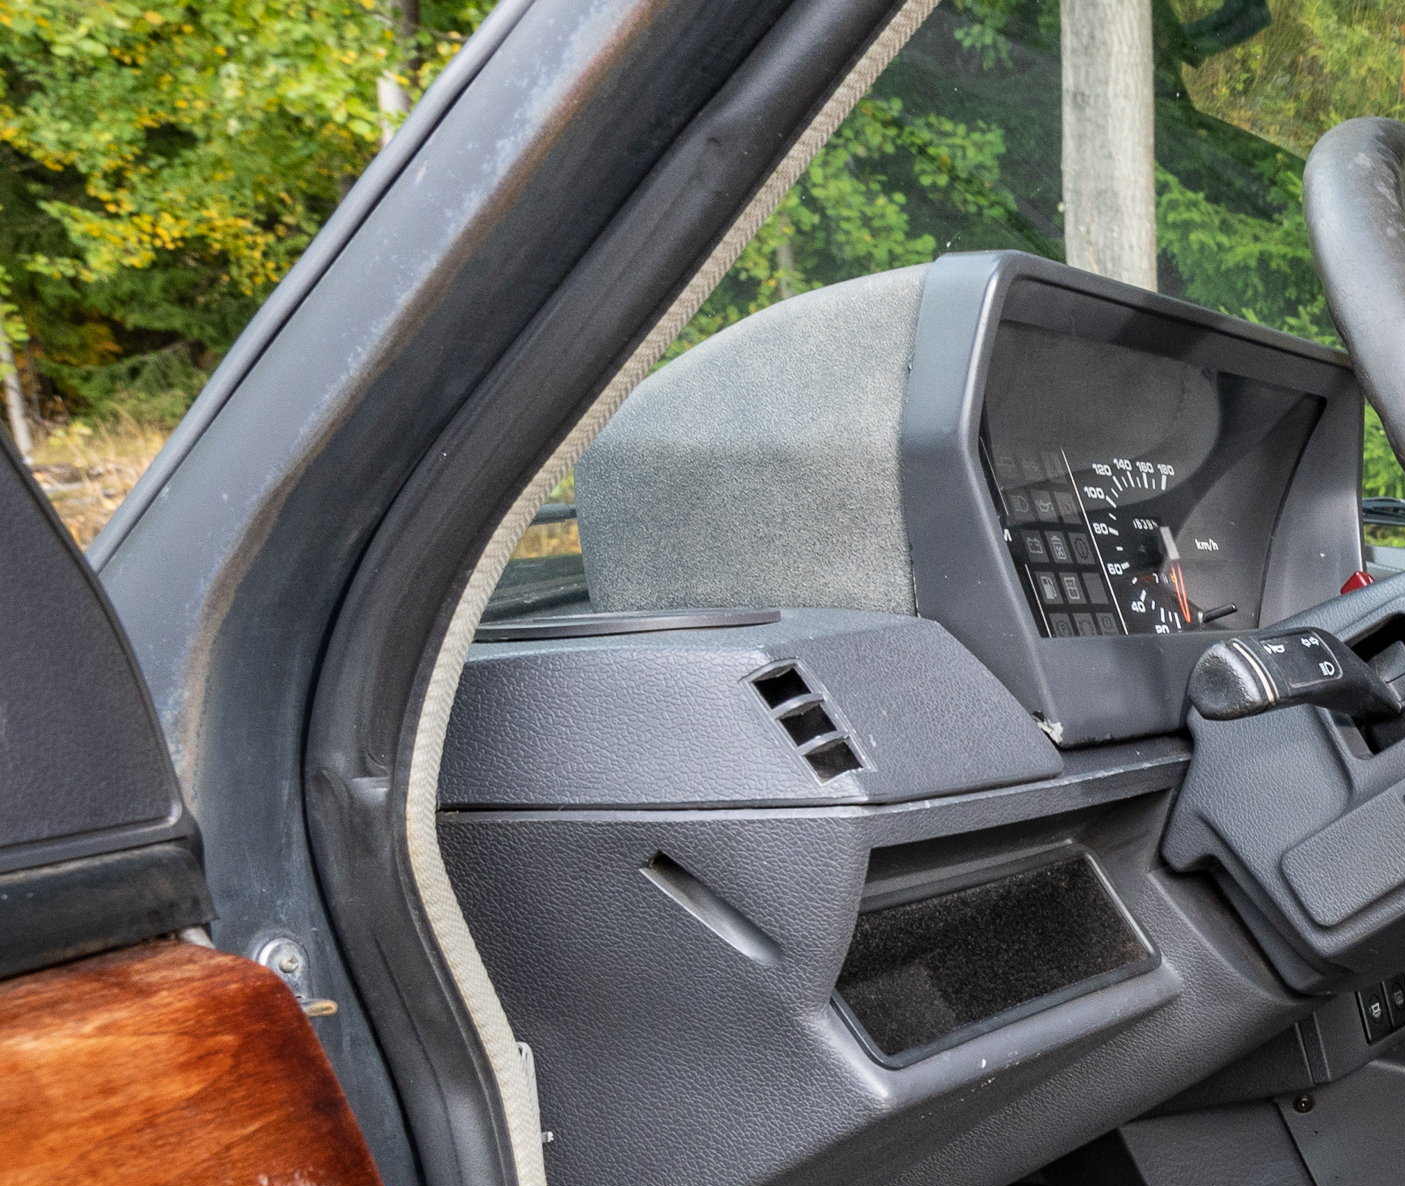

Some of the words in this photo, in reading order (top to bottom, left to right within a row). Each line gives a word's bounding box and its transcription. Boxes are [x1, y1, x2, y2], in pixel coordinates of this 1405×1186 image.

[1092, 463, 1112, 476] 120
[1113, 458, 1132, 471] 140
[1136, 461, 1154, 474] 160
[1157, 463, 1175, 476] 180
[1083, 486, 1105, 499] 100
[1092, 522, 1109, 535] 80
[1194, 538, 1219, 551] km/h
[1107, 563, 1123, 575] 60
[1131, 600, 1146, 613] 40
